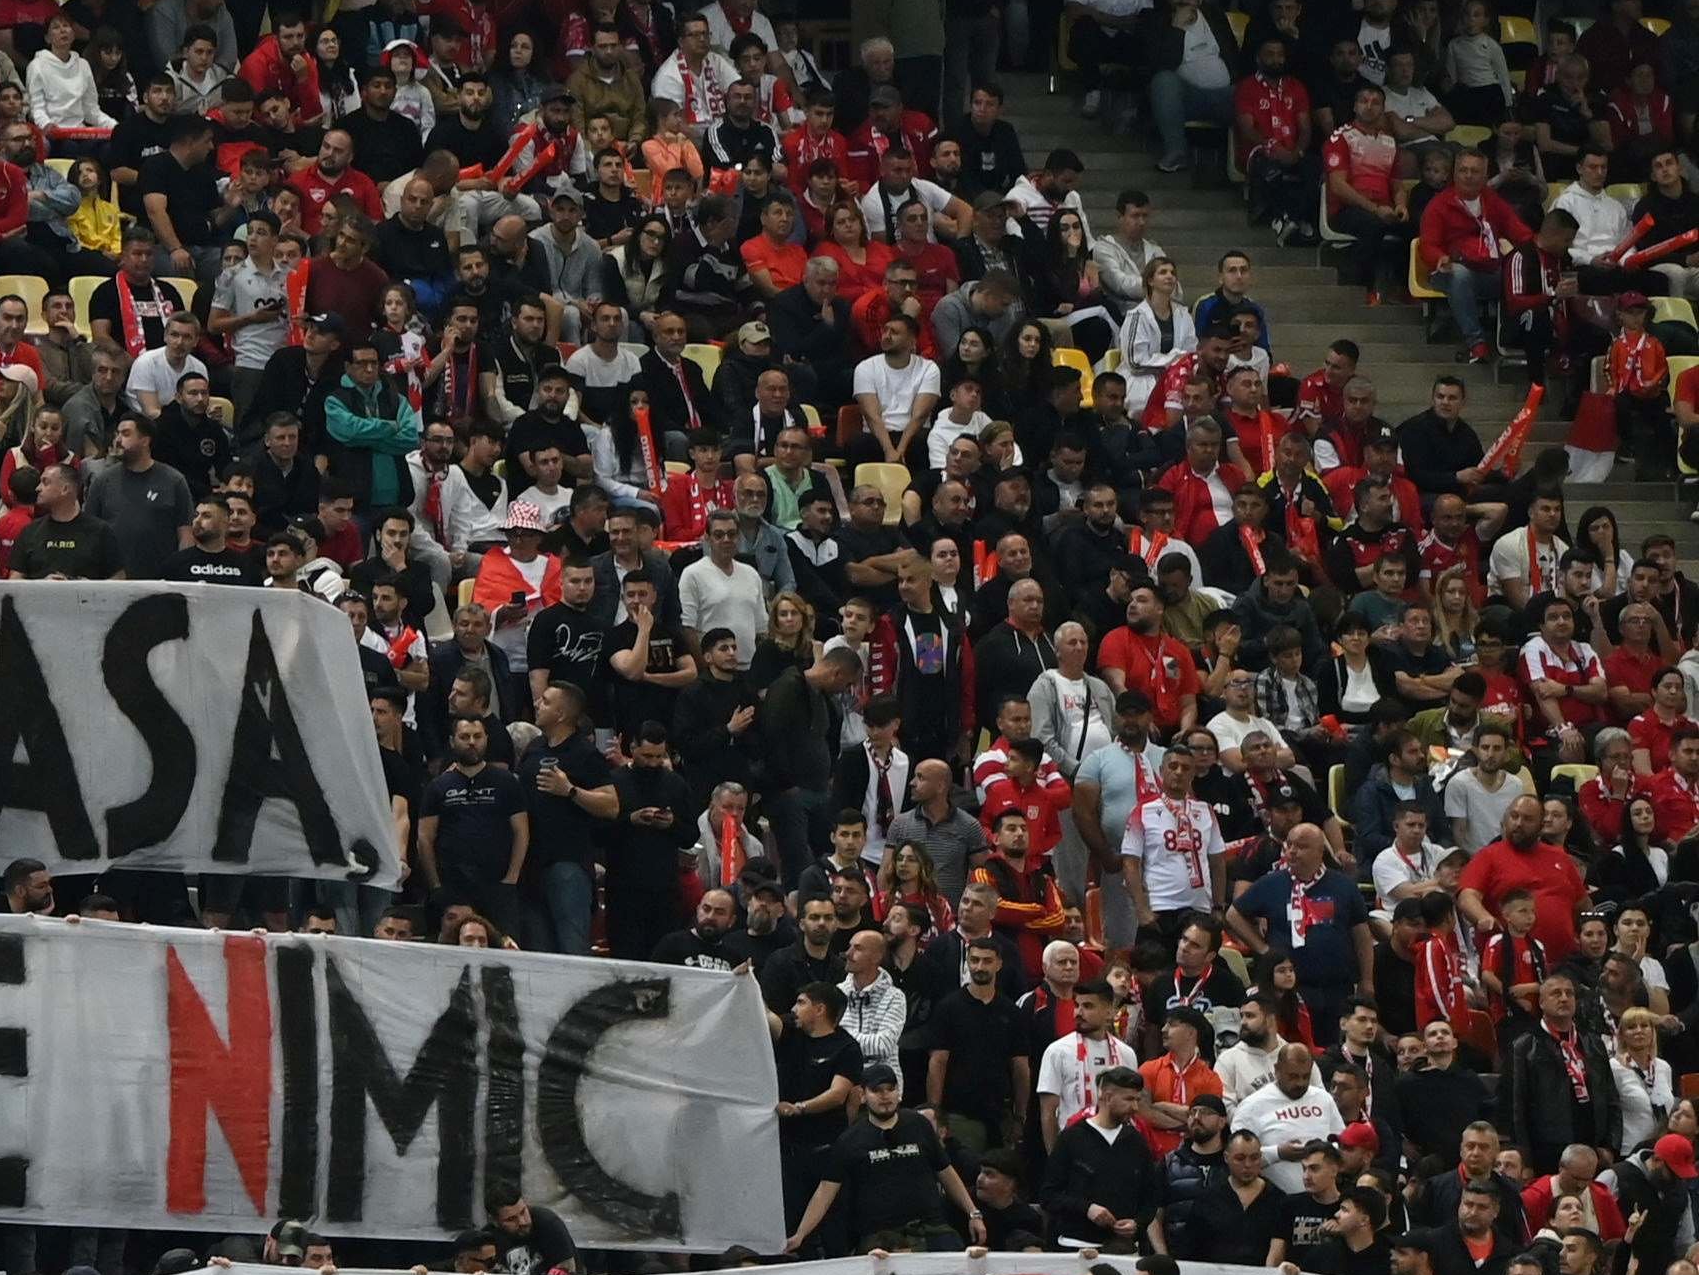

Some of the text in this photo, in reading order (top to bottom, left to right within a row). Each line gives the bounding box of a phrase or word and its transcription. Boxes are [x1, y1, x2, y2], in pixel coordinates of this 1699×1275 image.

[190, 564, 241, 576] adidas
[165, 933, 685, 1245] NIMIC
[1275, 1106, 1323, 1120] HUGO
